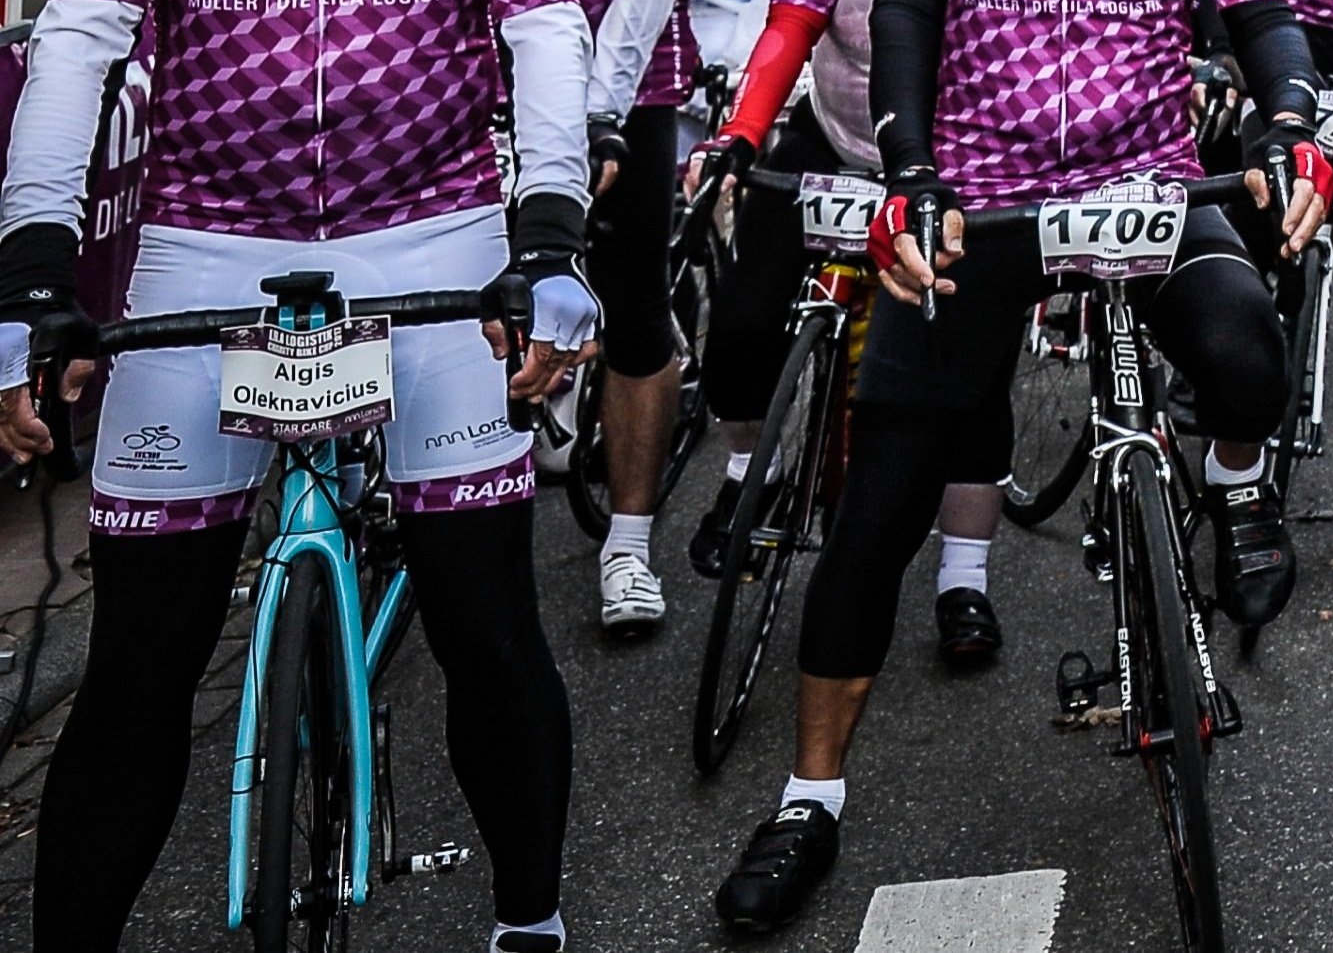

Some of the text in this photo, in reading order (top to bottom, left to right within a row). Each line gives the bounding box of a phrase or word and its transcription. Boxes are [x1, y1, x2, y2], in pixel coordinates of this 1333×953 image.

[1032, 0, 1057, 14] DIE
[805, 195, 878, 229] 171
[1047, 208, 1178, 246] 1706
[286, 326, 334, 347] LOGISTIK
[1105, 303, 1144, 407] BMC
[274, 362, 335, 387] Algis
[233, 379, 380, 414] Oleknavicius
[301, 419, 332, 434] CARE
[466, 415, 509, 440] Lors
[454, 470, 536, 503] RADSP
[1117, 626, 1133, 712] EASTON
[1190, 612, 1217, 693] EASTON
